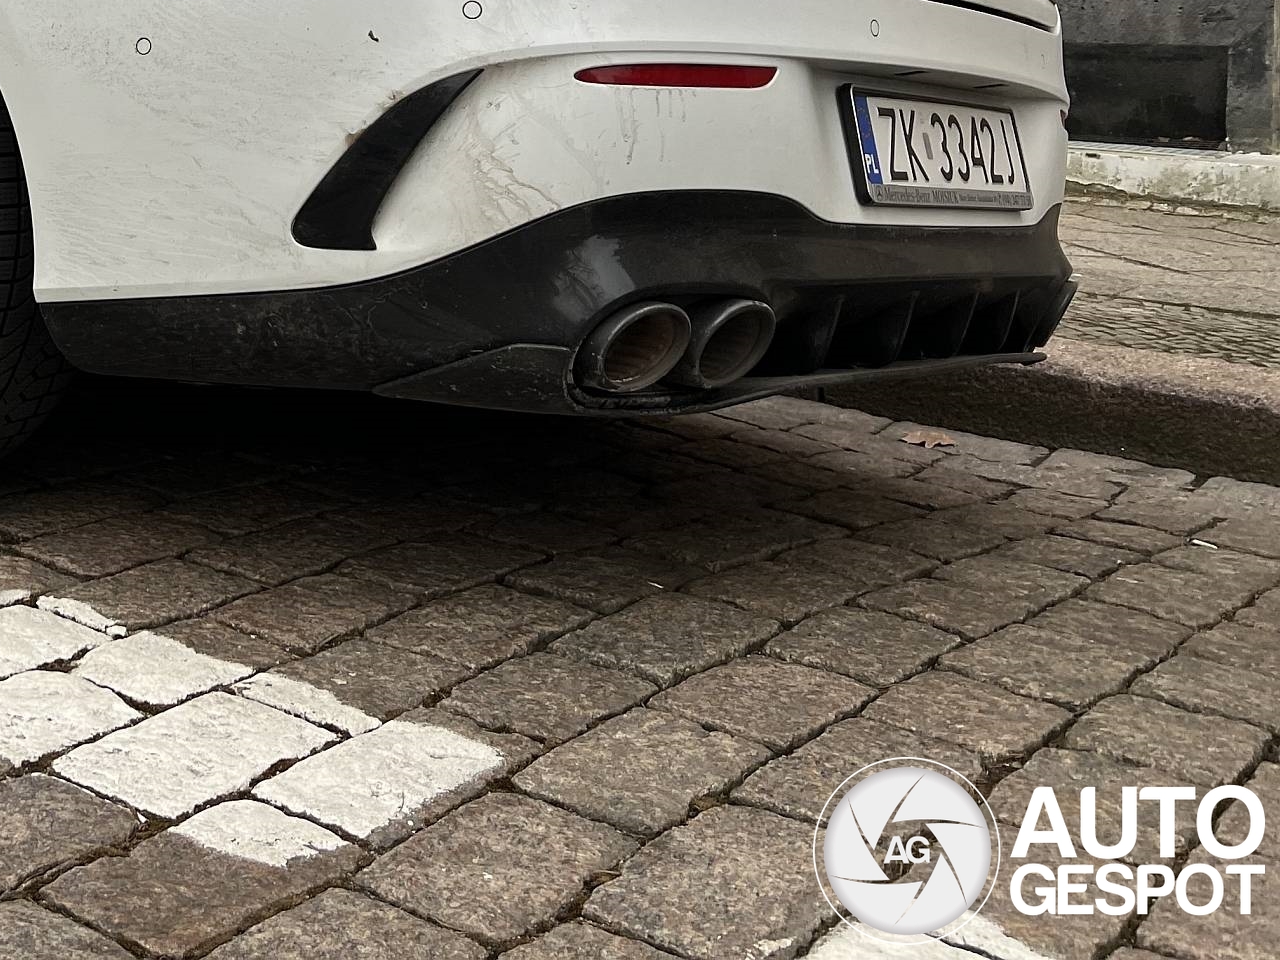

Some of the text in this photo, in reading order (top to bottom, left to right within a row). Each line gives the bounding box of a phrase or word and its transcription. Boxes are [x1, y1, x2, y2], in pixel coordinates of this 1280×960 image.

[863, 152, 880, 175] PL
[877, 106, 1016, 185] ZK 3342J
